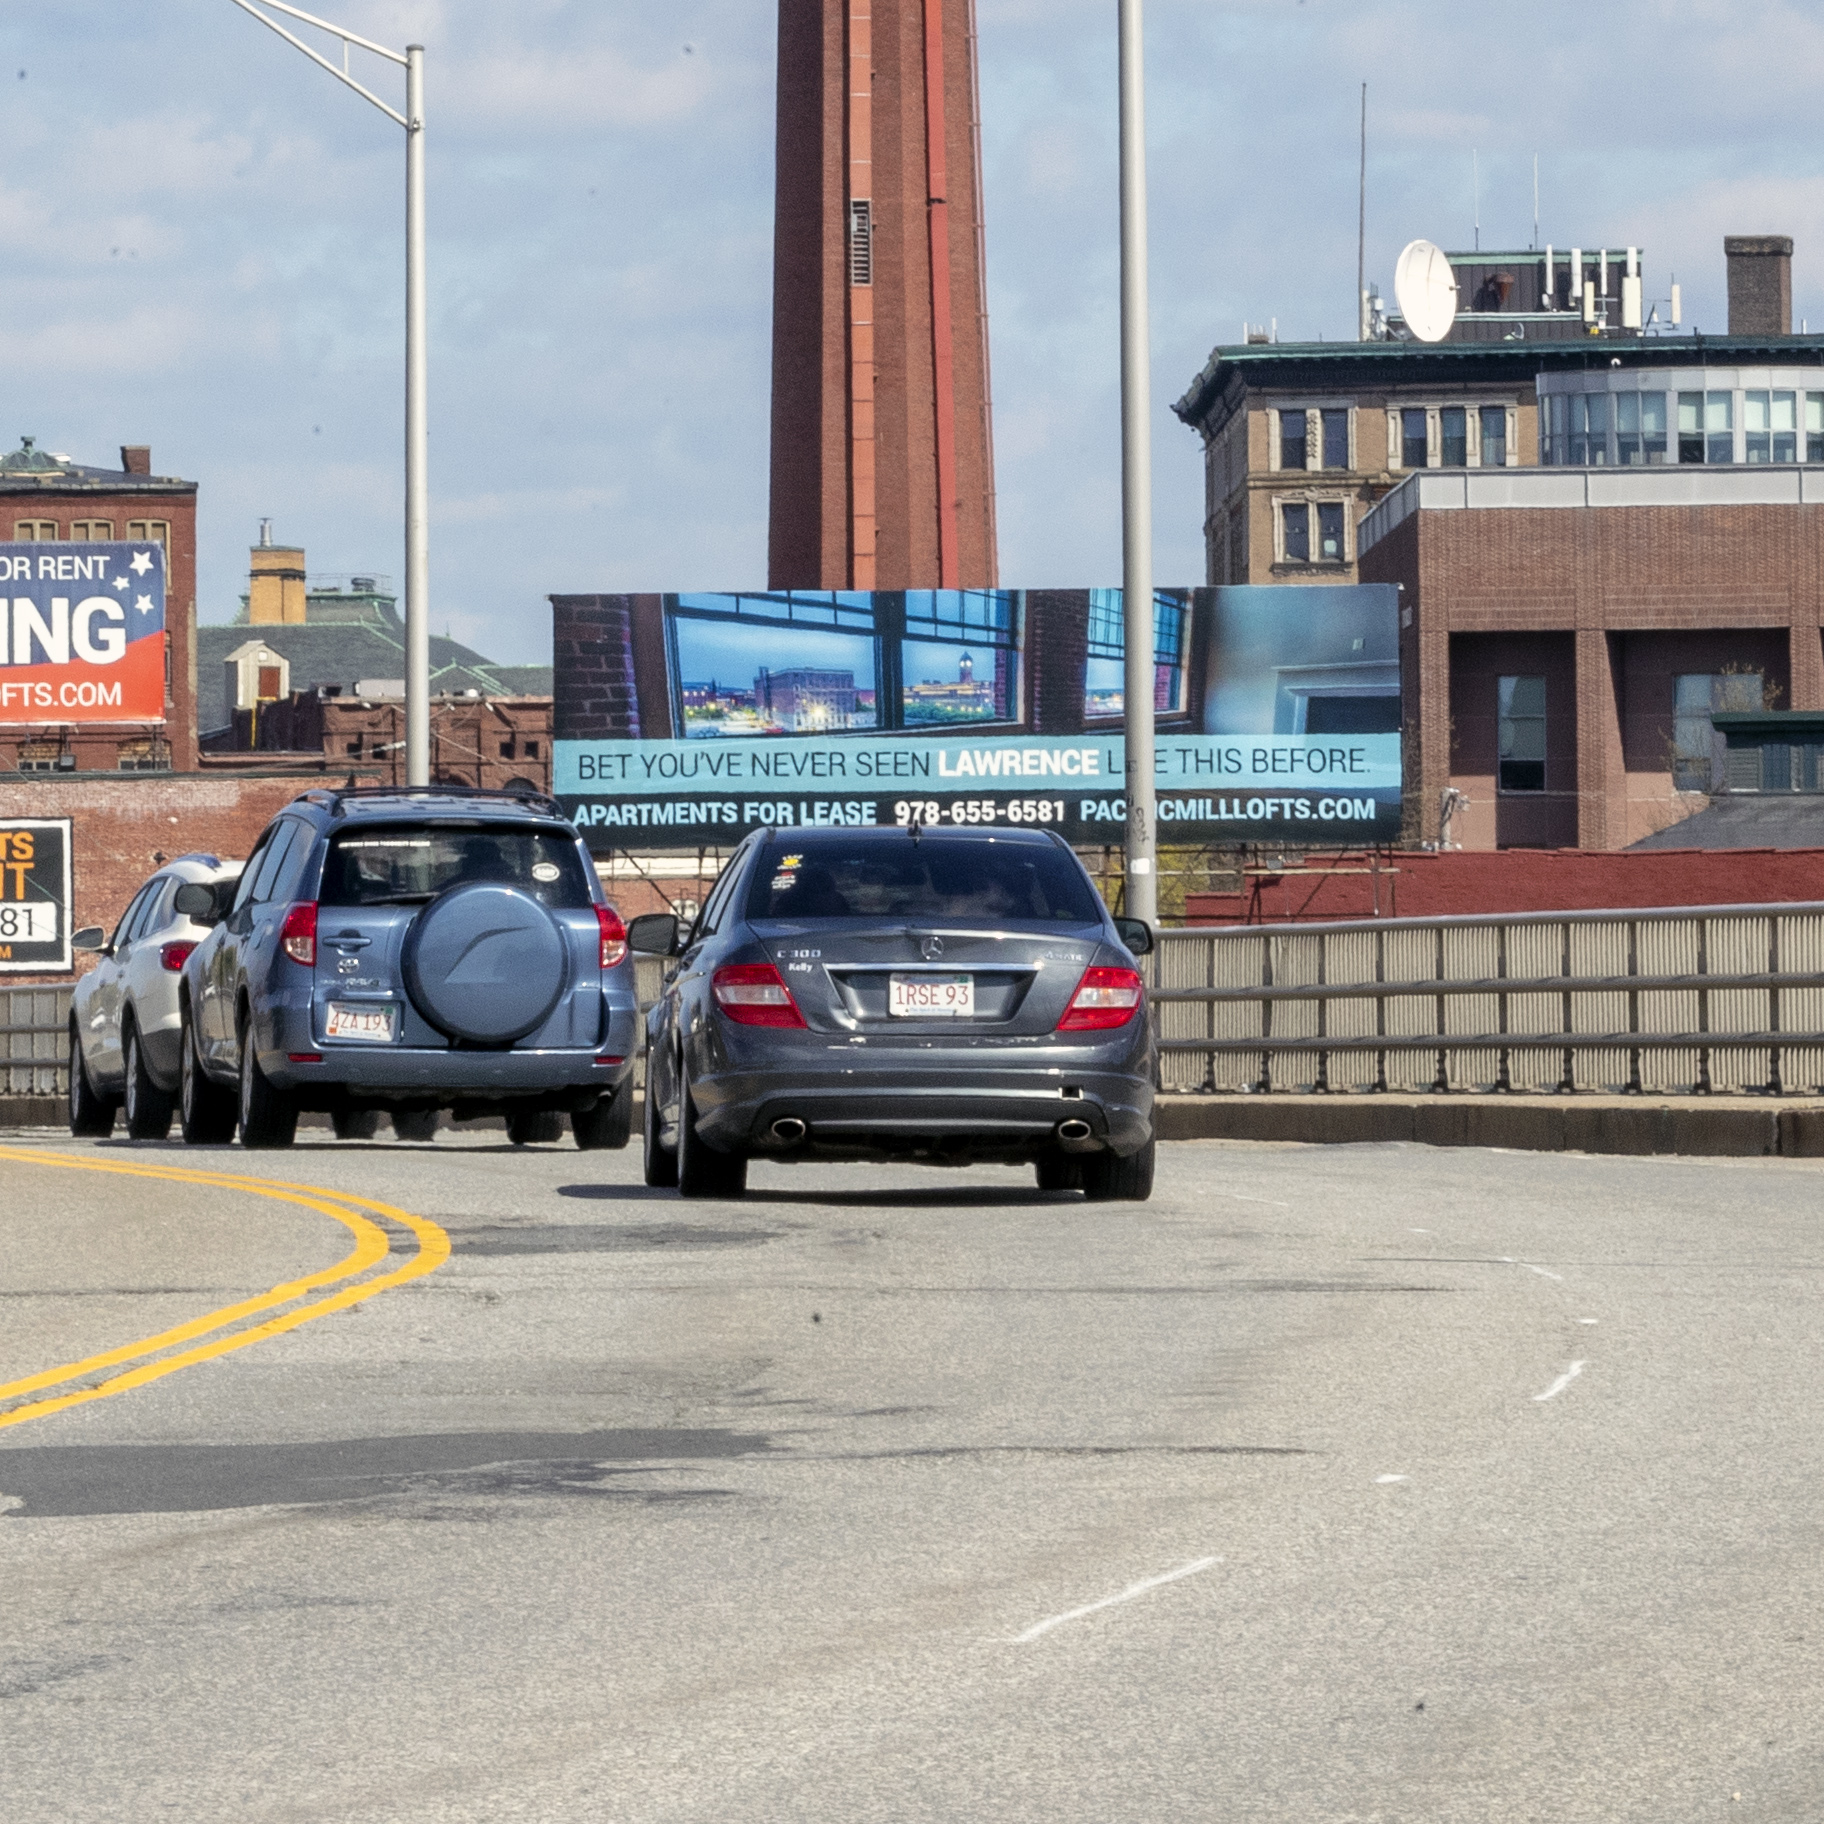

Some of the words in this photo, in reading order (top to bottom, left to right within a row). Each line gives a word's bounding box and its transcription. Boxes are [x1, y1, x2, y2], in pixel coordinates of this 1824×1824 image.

[38, 555, 111, 581] RENT
[579, 753, 632, 779] BET
[641, 751, 743, 778] YOU'VE
[751, 751, 846, 777] NEVER
[855, 751, 930, 777] SEEN
[937, 749, 1100, 776] LAWRENCE
[1107, 749, 1168, 774] LE
[1179, 748, 1242, 774] THIS
[1252, 747, 1370, 774] BEFORE.
[574, 801, 738, 827] APARTMENTS
[743, 801, 794, 825] FOR
[800, 800, 877, 826] LEASE
[894, 800, 1065, 827] 978-655-6581
[1080, 797, 1376, 822] PACICMILLLOFTS.COM
[895, 984, 940, 1005] 1RSE
[945, 985, 969, 1005] 93
